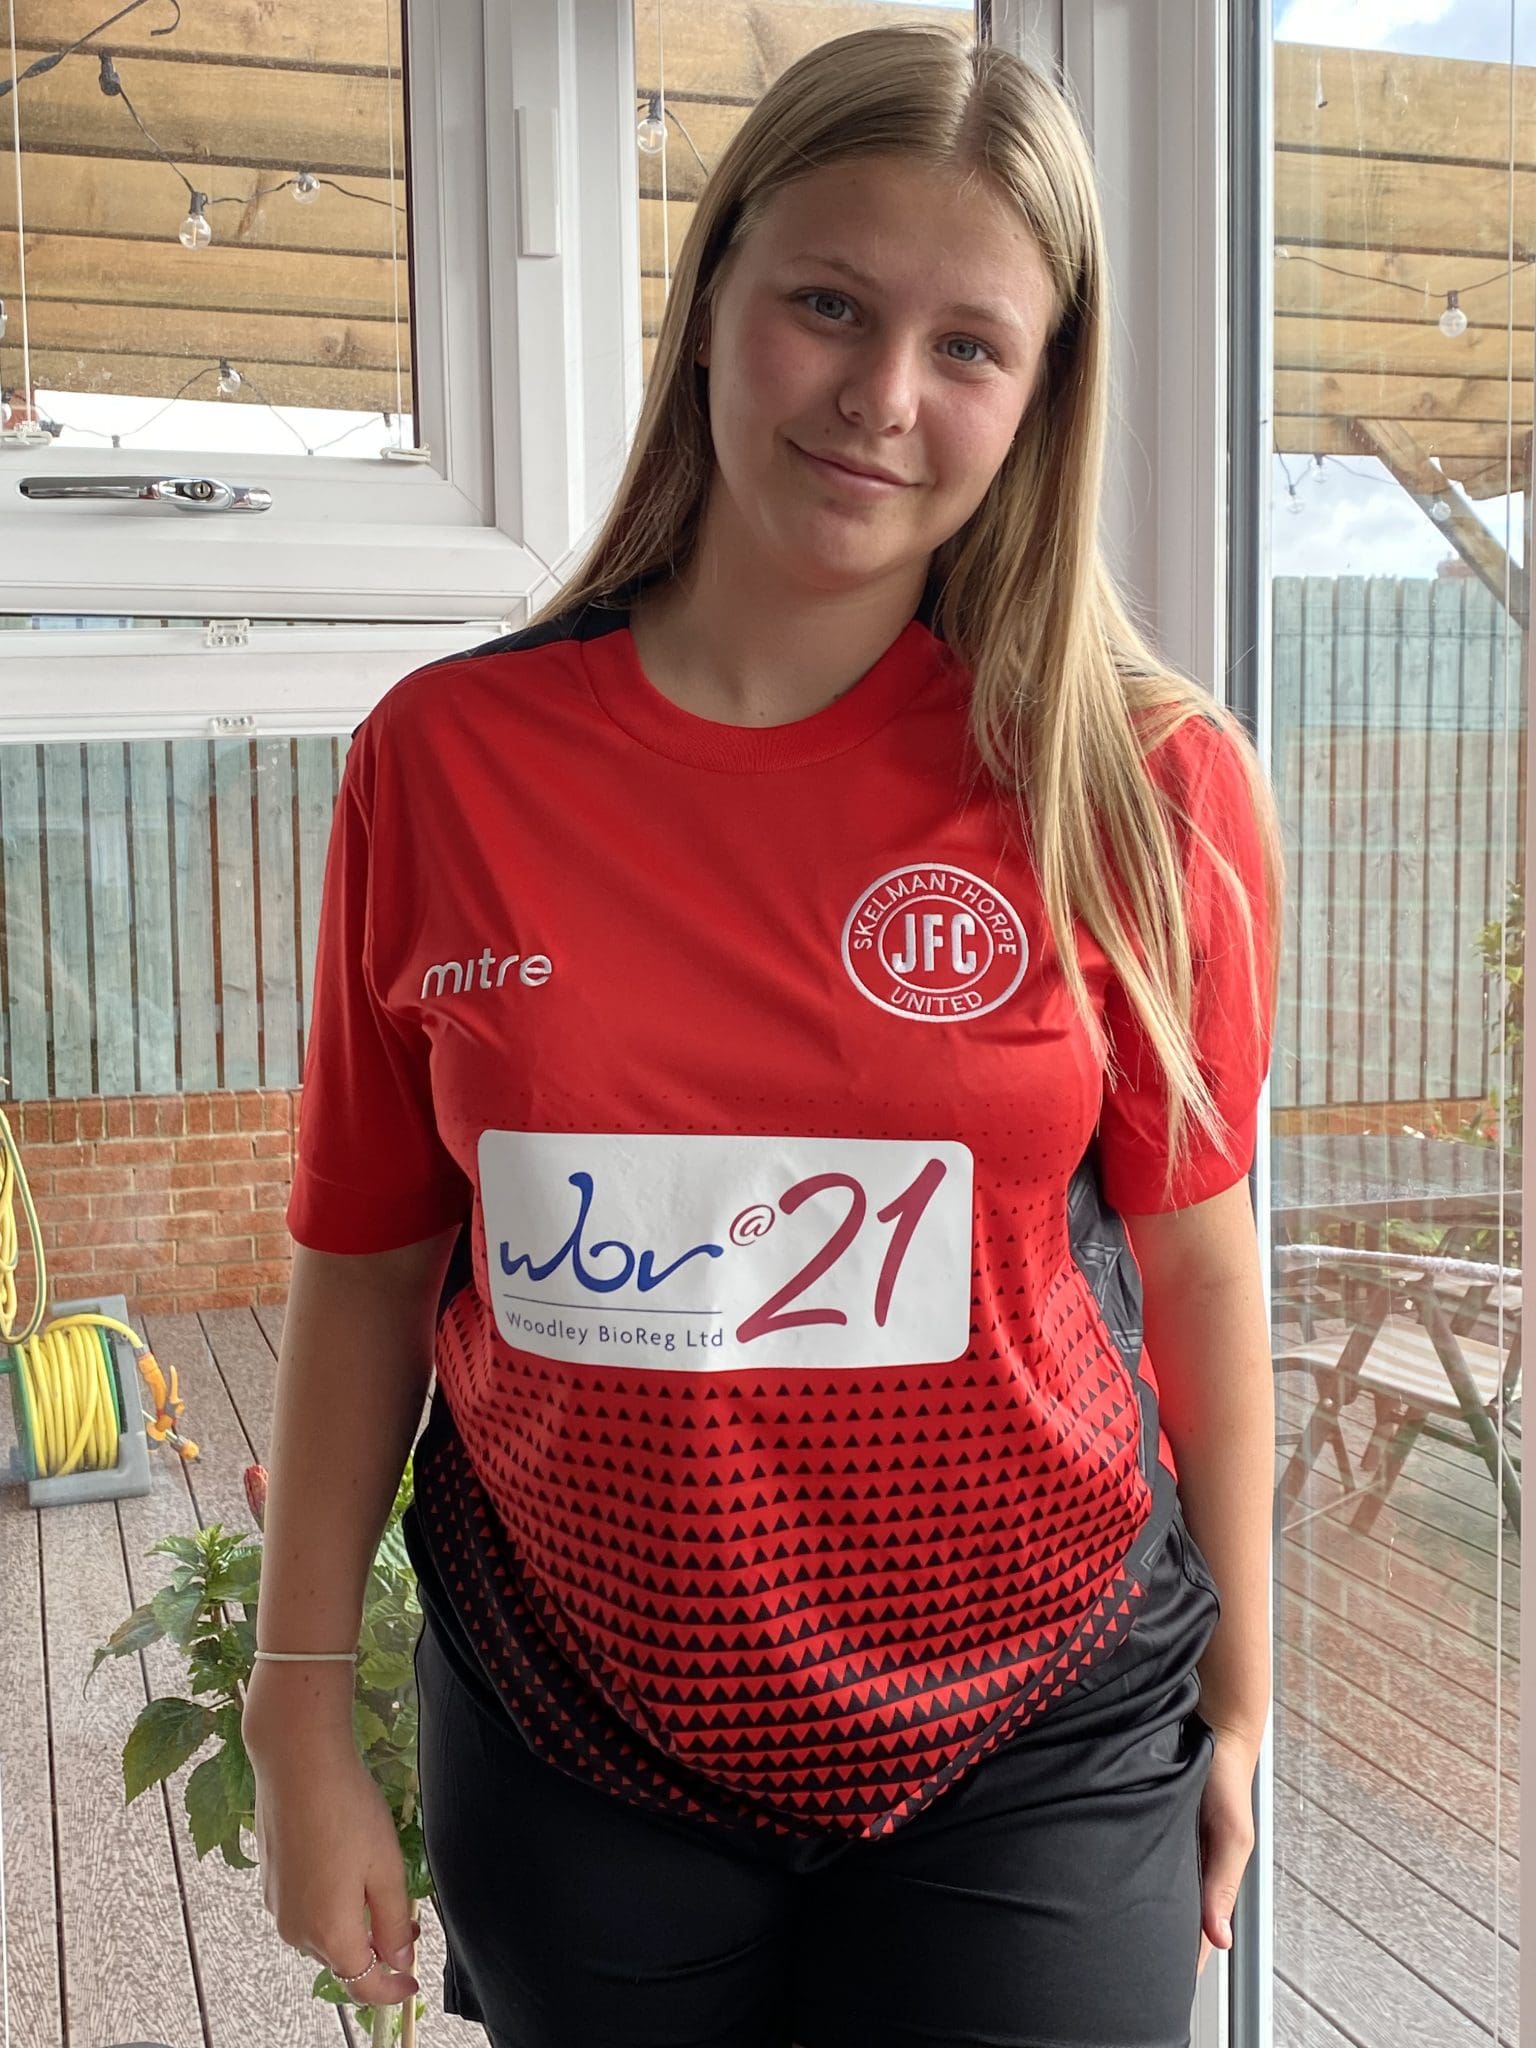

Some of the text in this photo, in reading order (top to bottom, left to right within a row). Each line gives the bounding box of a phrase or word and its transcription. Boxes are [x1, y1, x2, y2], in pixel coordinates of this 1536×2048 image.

[853, 872, 1017, 956] SKELMANTHORPE
[891, 912, 977, 975] JFC
[421, 948, 553, 1000] mitre
[890, 985, 983, 1014] UNITED
[505, 1310, 724, 1352] Woodley BioReg Ltd
